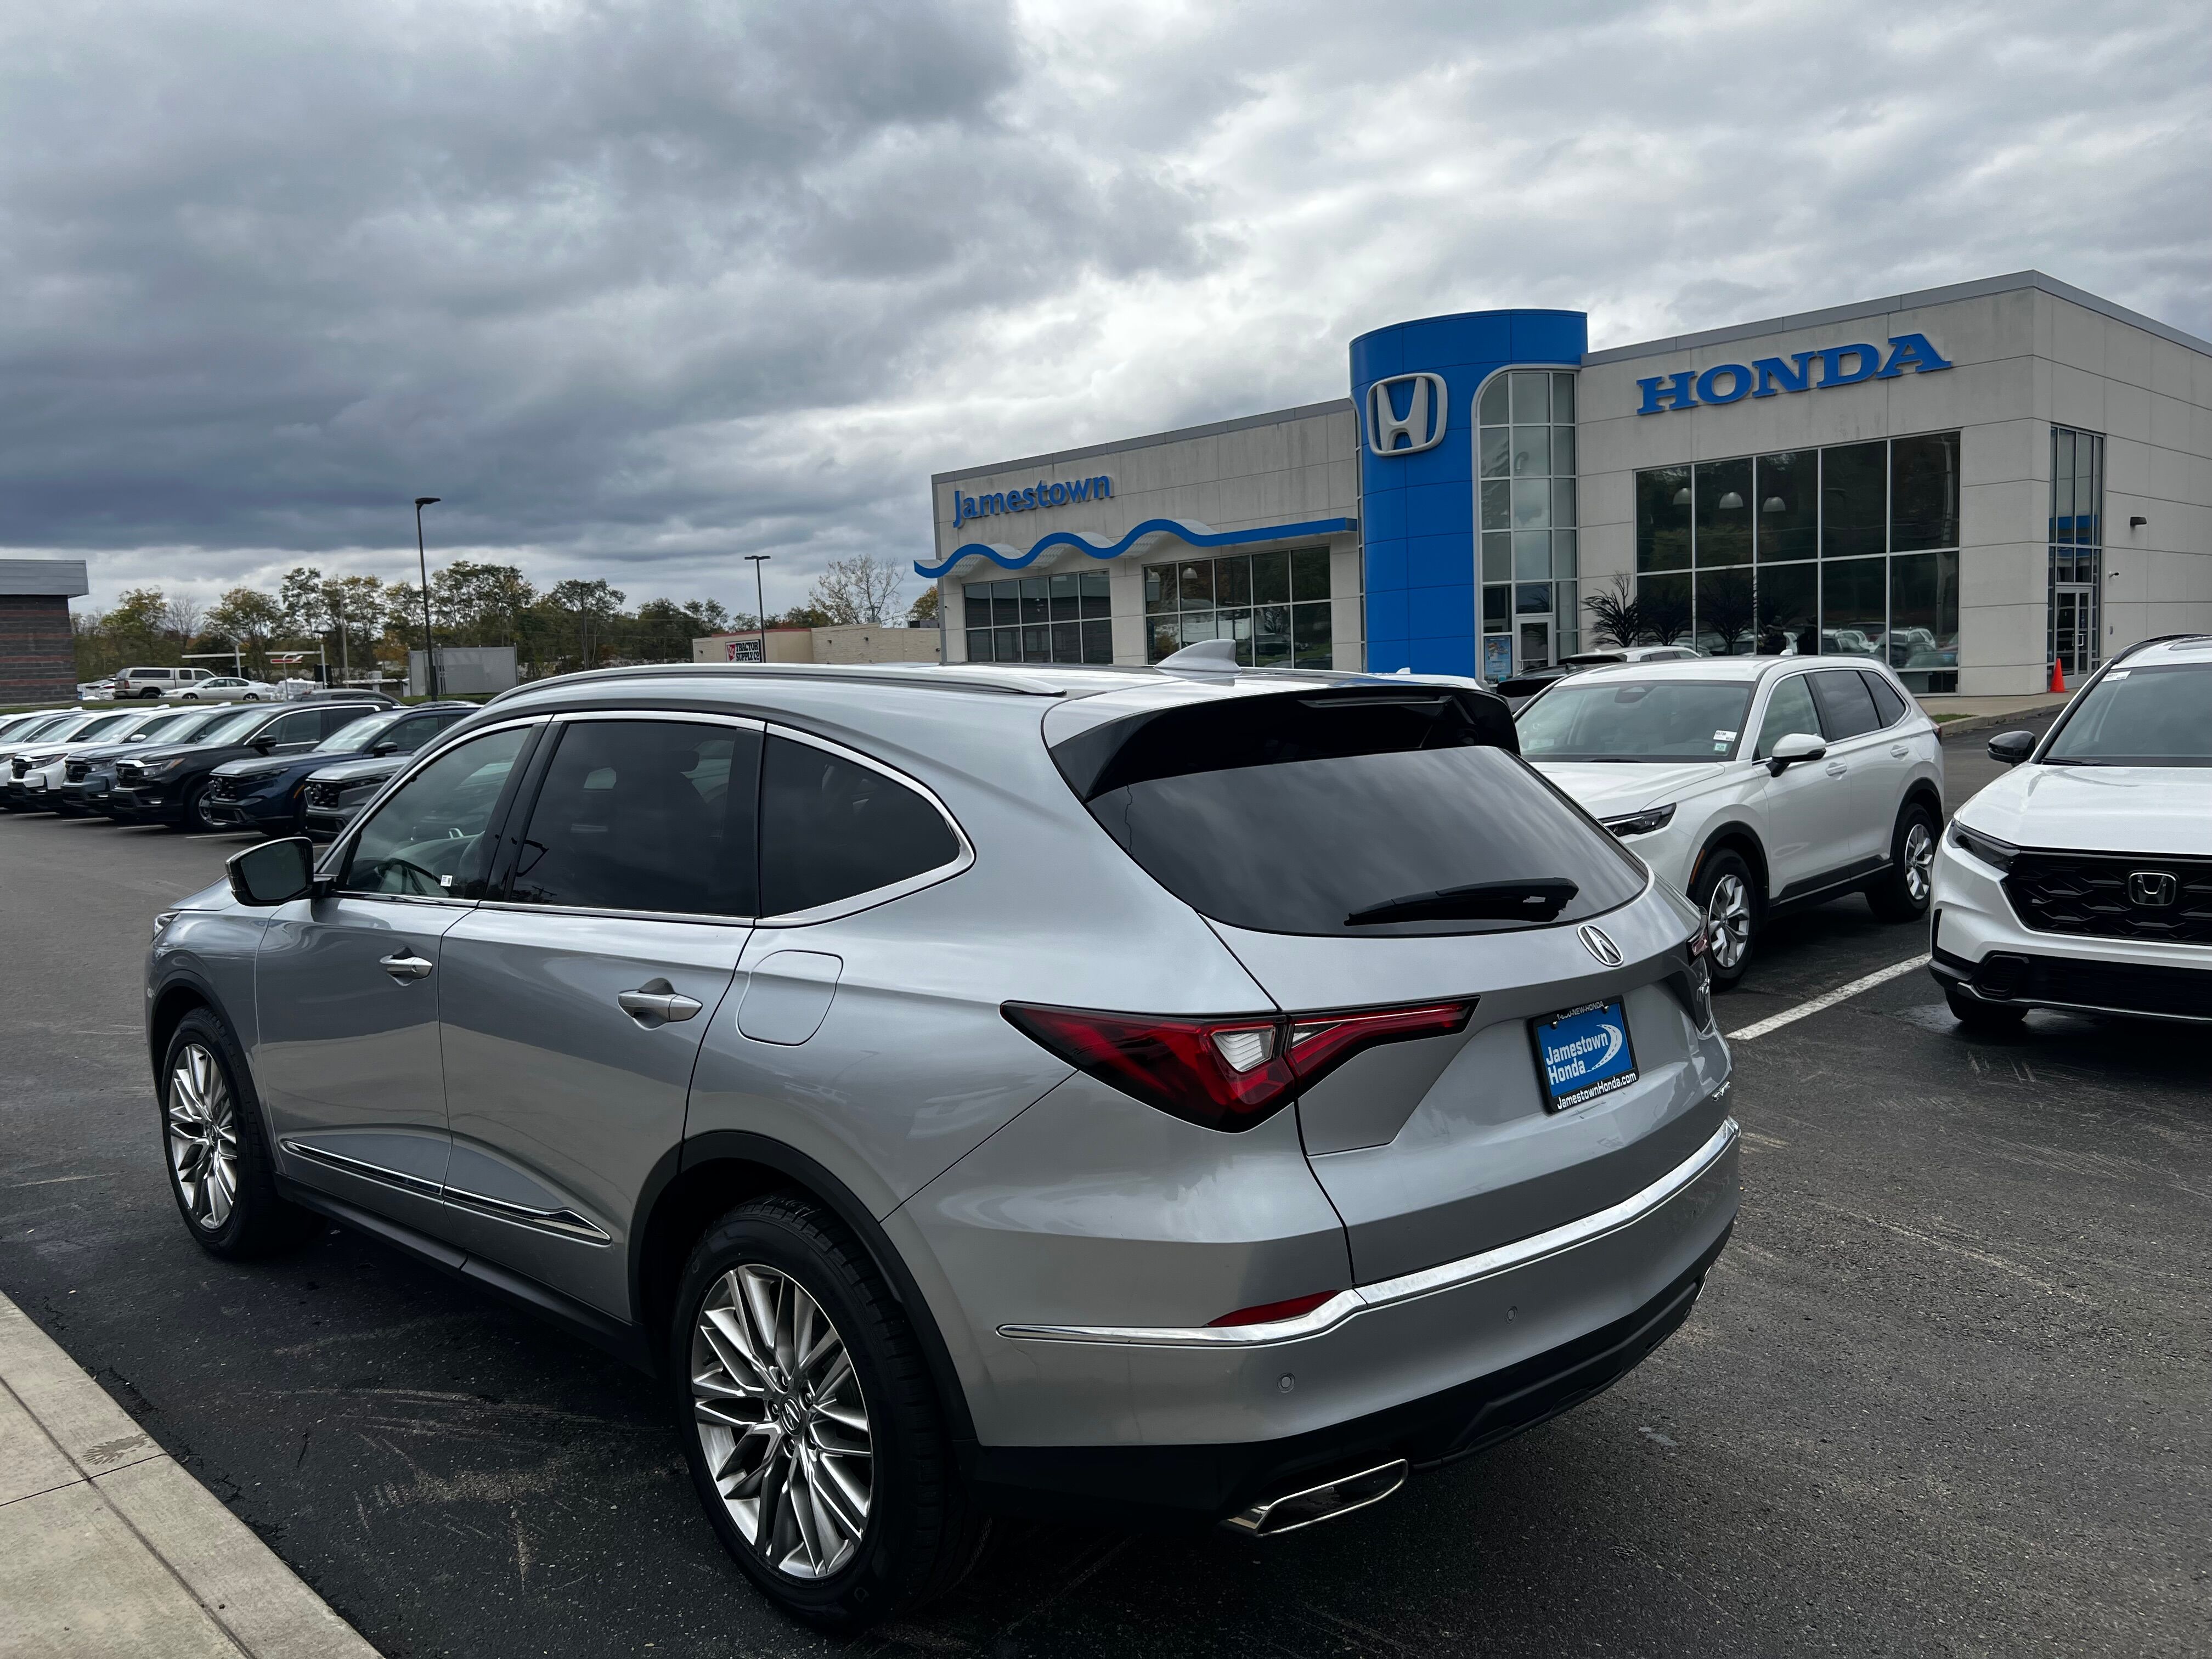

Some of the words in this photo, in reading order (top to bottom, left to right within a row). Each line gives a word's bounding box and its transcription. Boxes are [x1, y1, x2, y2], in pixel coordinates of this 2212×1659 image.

[1637, 333, 1952, 415] HONDA
[953, 475, 1112, 528] Jamestown
[736, 642, 759, 652] TRACTOR
[736, 652, 753, 661] SUPPLY
[1545, 1032, 1609, 1065] Jamestown
[1548, 1057, 1586, 1085] Honda
[1557, 1072, 1637, 1110] JamestownHonda.com
